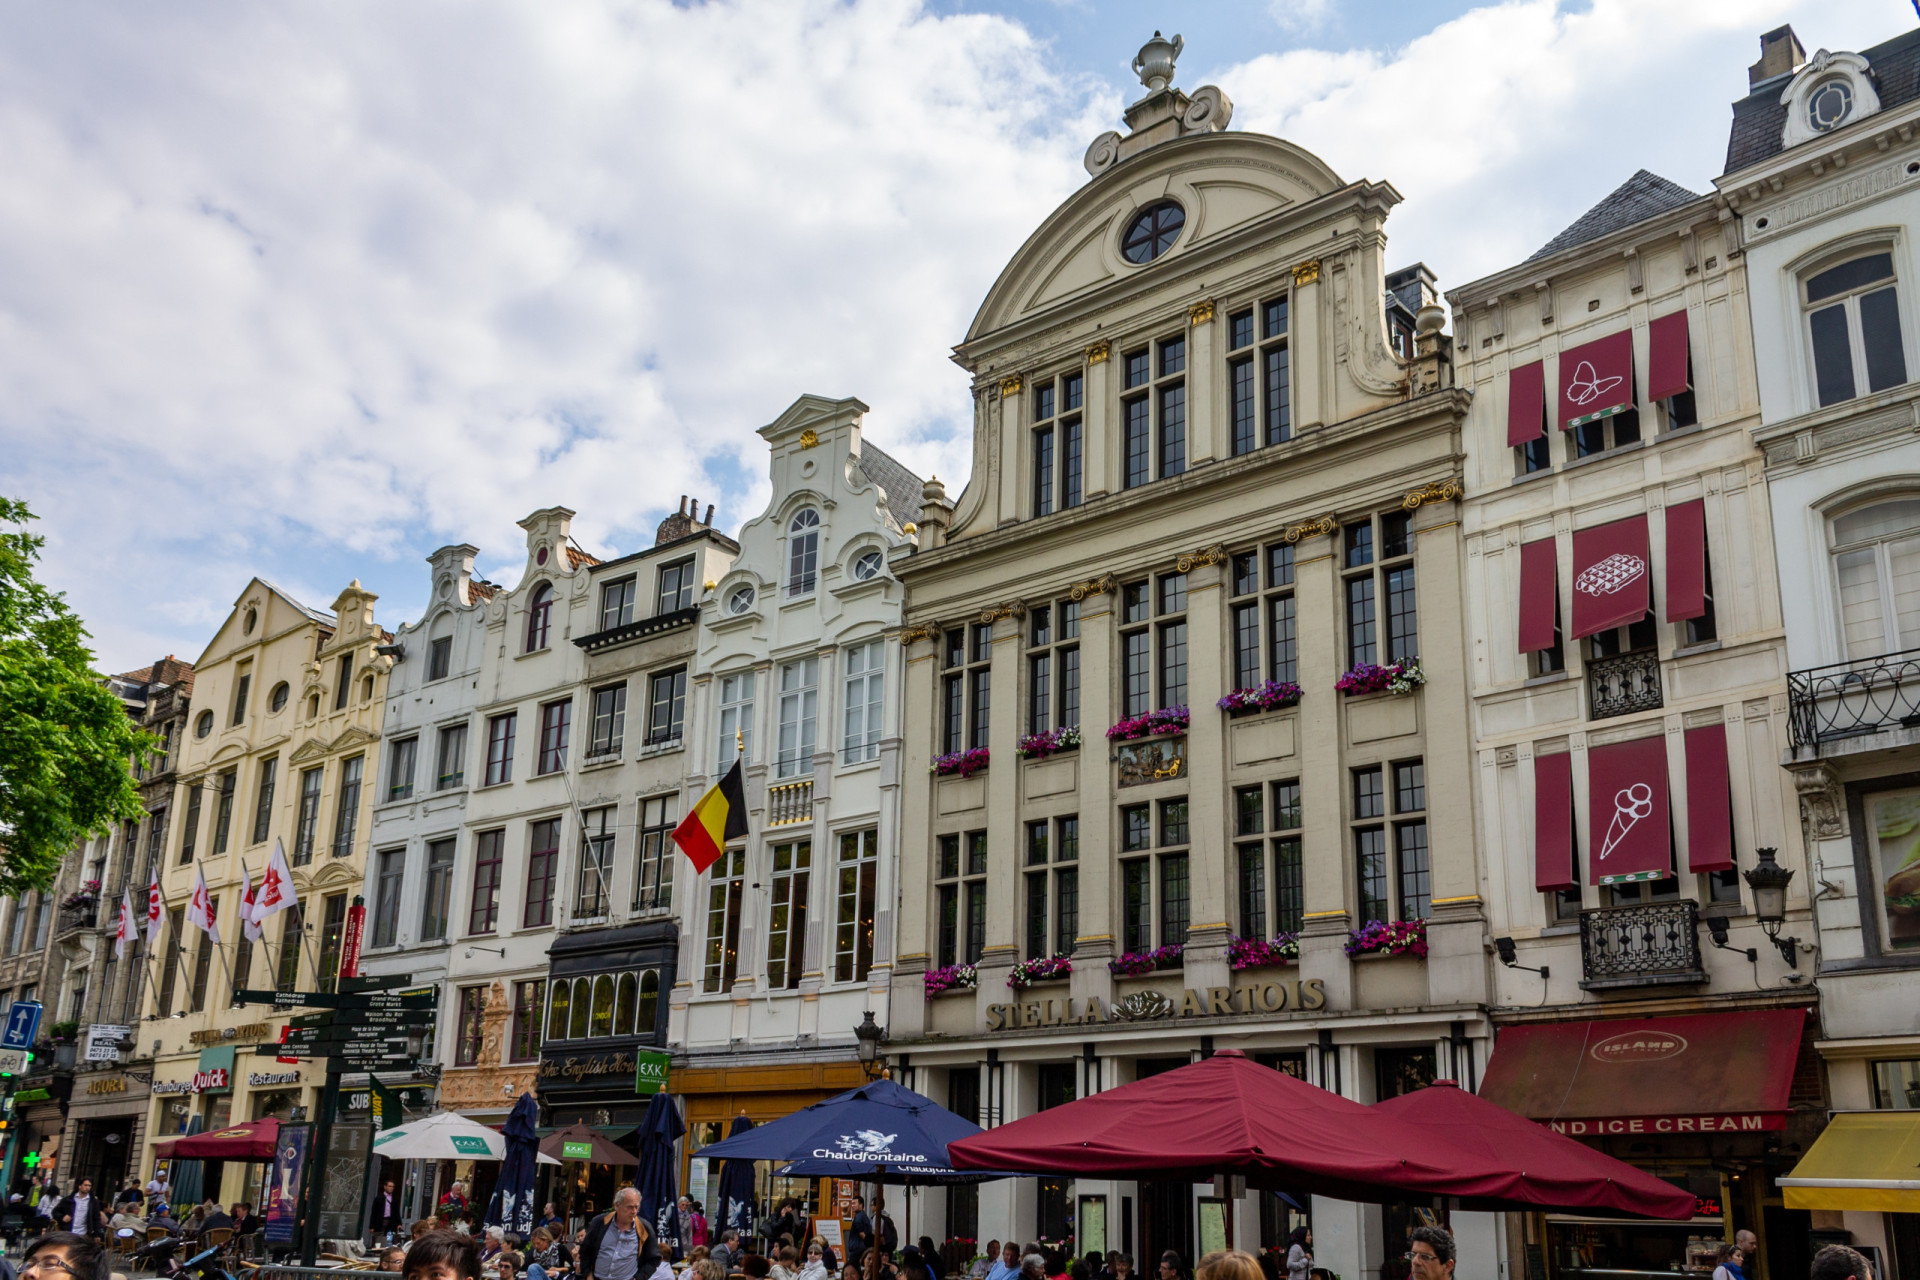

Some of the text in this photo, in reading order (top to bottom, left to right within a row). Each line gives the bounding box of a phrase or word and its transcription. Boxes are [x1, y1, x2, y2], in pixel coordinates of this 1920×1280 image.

[552, 1000, 569, 1008] TAILOR
[640, 991, 658, 1000] TAILOR
[985, 977, 1326, 1031] STELLA ARTOIS
[593, 1011, 611, 1020] LONDON
[1603, 1041, 1675, 1052] ISLAND
[540, 1059, 560, 1078] The
[562, 1055, 607, 1082] English
[87, 1076, 126, 1095] AGORA
[152, 1069, 298, 1095] Hamburger Quick Restaurant
[348, 1093, 370, 1110] SUB
[372, 1089, 383, 1130] UBWAY
[1551, 1116, 1763, 1134] ND ICE CREAM
